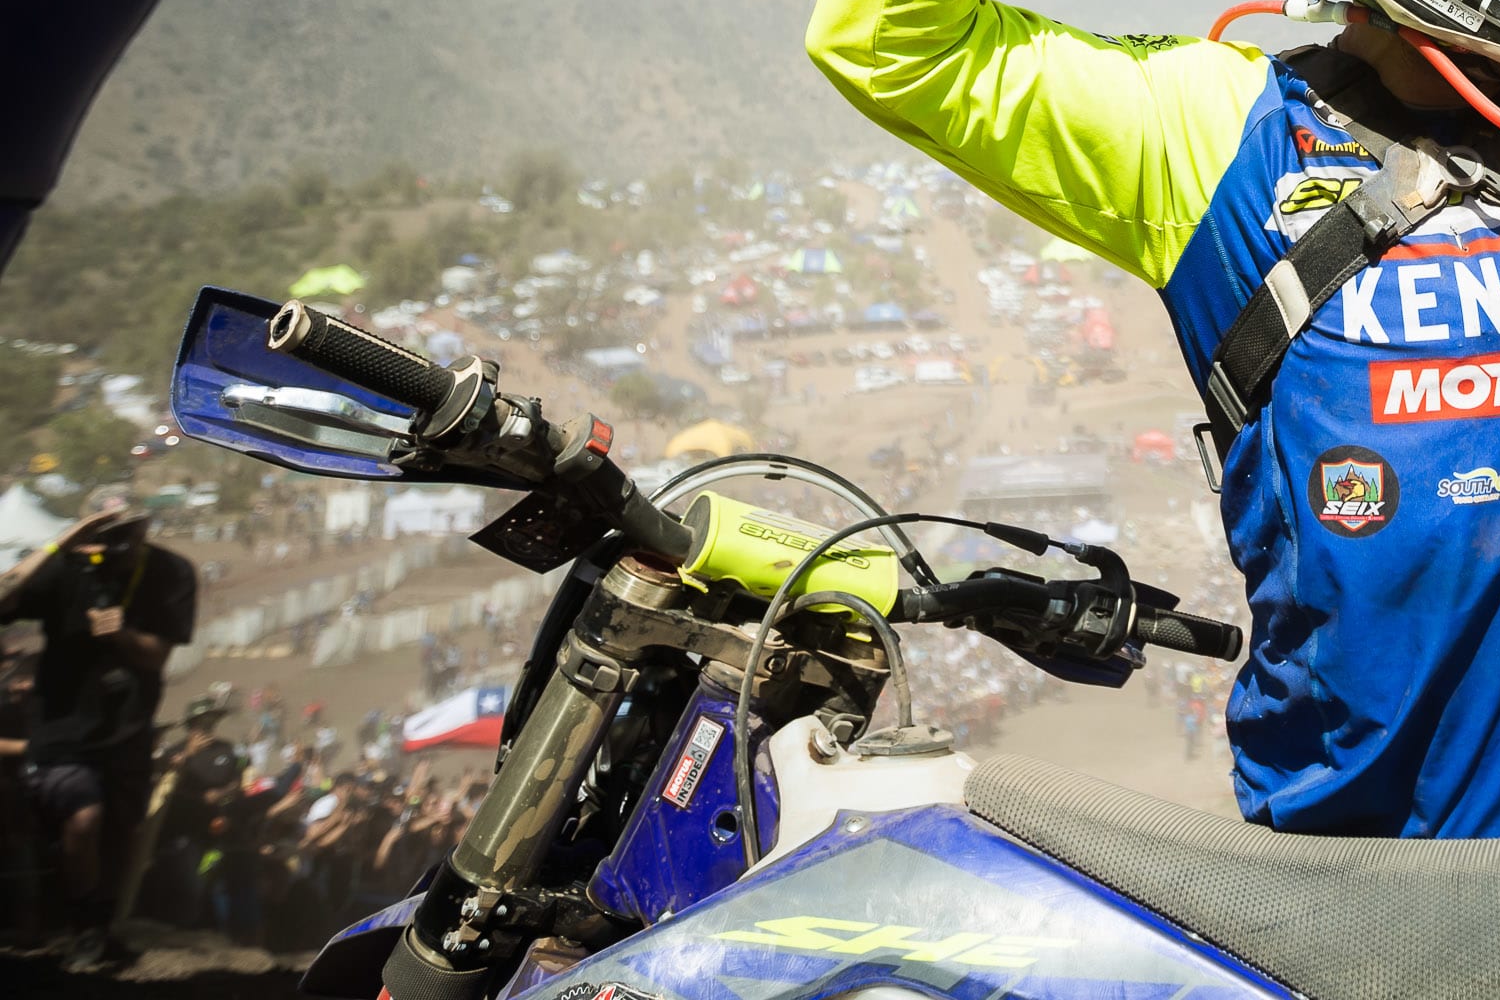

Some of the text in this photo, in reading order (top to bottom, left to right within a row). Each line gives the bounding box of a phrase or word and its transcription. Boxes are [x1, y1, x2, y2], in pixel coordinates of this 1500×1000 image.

[1447, 5, 1475, 26] BTAG
[1438, 479, 1493, 497] SOUTH
[1322, 500, 1386, 516] SEIX
[669, 758, 693, 796] MOTUL
[676, 761, 703, 803] INSIDE
